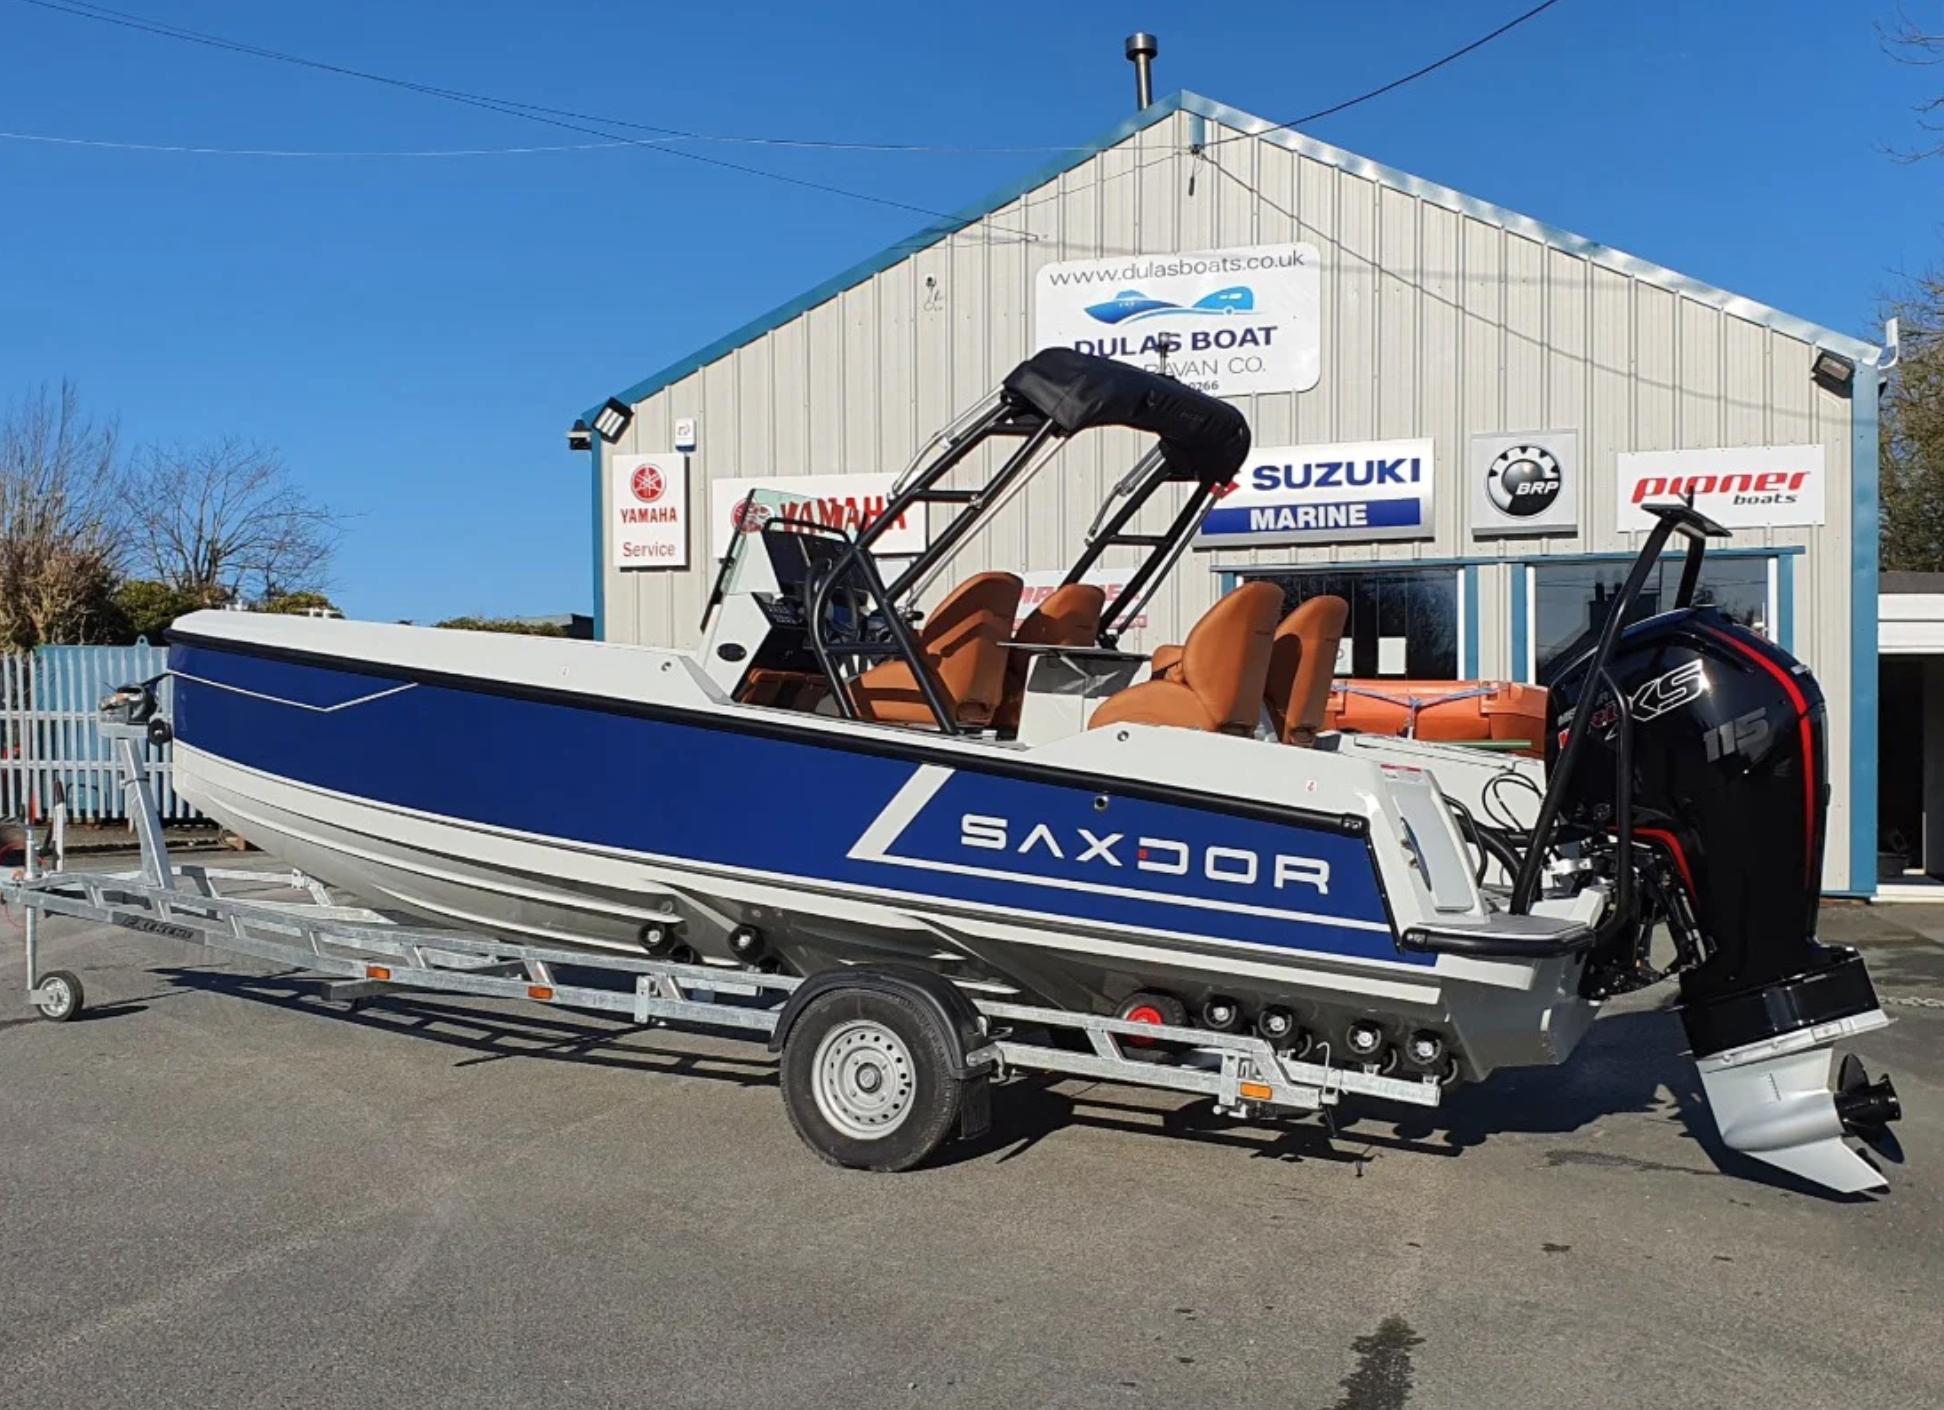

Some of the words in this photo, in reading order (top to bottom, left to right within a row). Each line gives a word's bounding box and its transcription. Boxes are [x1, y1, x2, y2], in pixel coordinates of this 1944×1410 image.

[1050, 250, 1304, 286] www.dulasboats.co.uk
[1074, 333, 1182, 358] DULAS
[1191, 326, 1278, 351] BOAT
[1144, 359, 1218, 377] RAVAN
[1229, 356, 1266, 374] CO.
[1252, 458, 1421, 491] SUZUKI
[1515, 481, 1559, 495] BRP
[1632, 471, 1811, 504] pioner
[1733, 494, 1797, 505] boats
[620, 507, 678, 523] YAMAHA
[1251, 504, 1368, 530] MARINE
[623, 541, 676, 557] Service
[1703, 706, 1769, 763] 115
[961, 813, 1330, 894] SAXDOR
